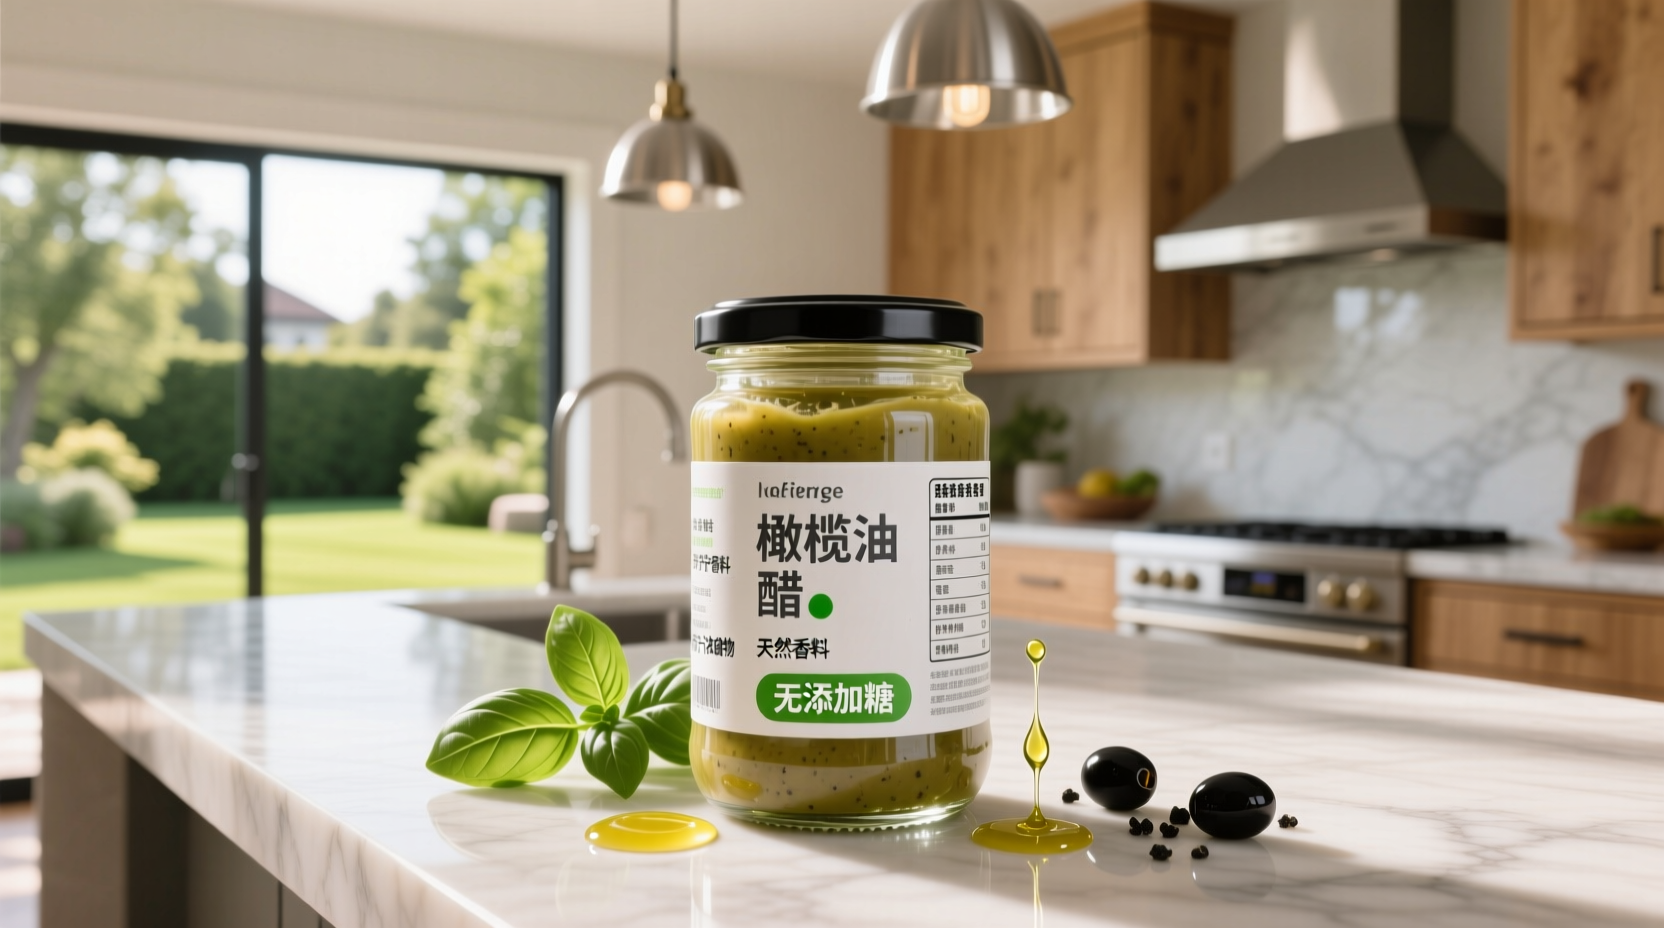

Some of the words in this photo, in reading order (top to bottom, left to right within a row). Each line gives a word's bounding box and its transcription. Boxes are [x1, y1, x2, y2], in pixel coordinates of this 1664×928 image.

[756, 513, 898, 564] 橄榄油
[757, 570, 804, 619] 醋
[757, 637, 830, 660] 天然香料
[774, 681, 895, 715] 无添加糖
